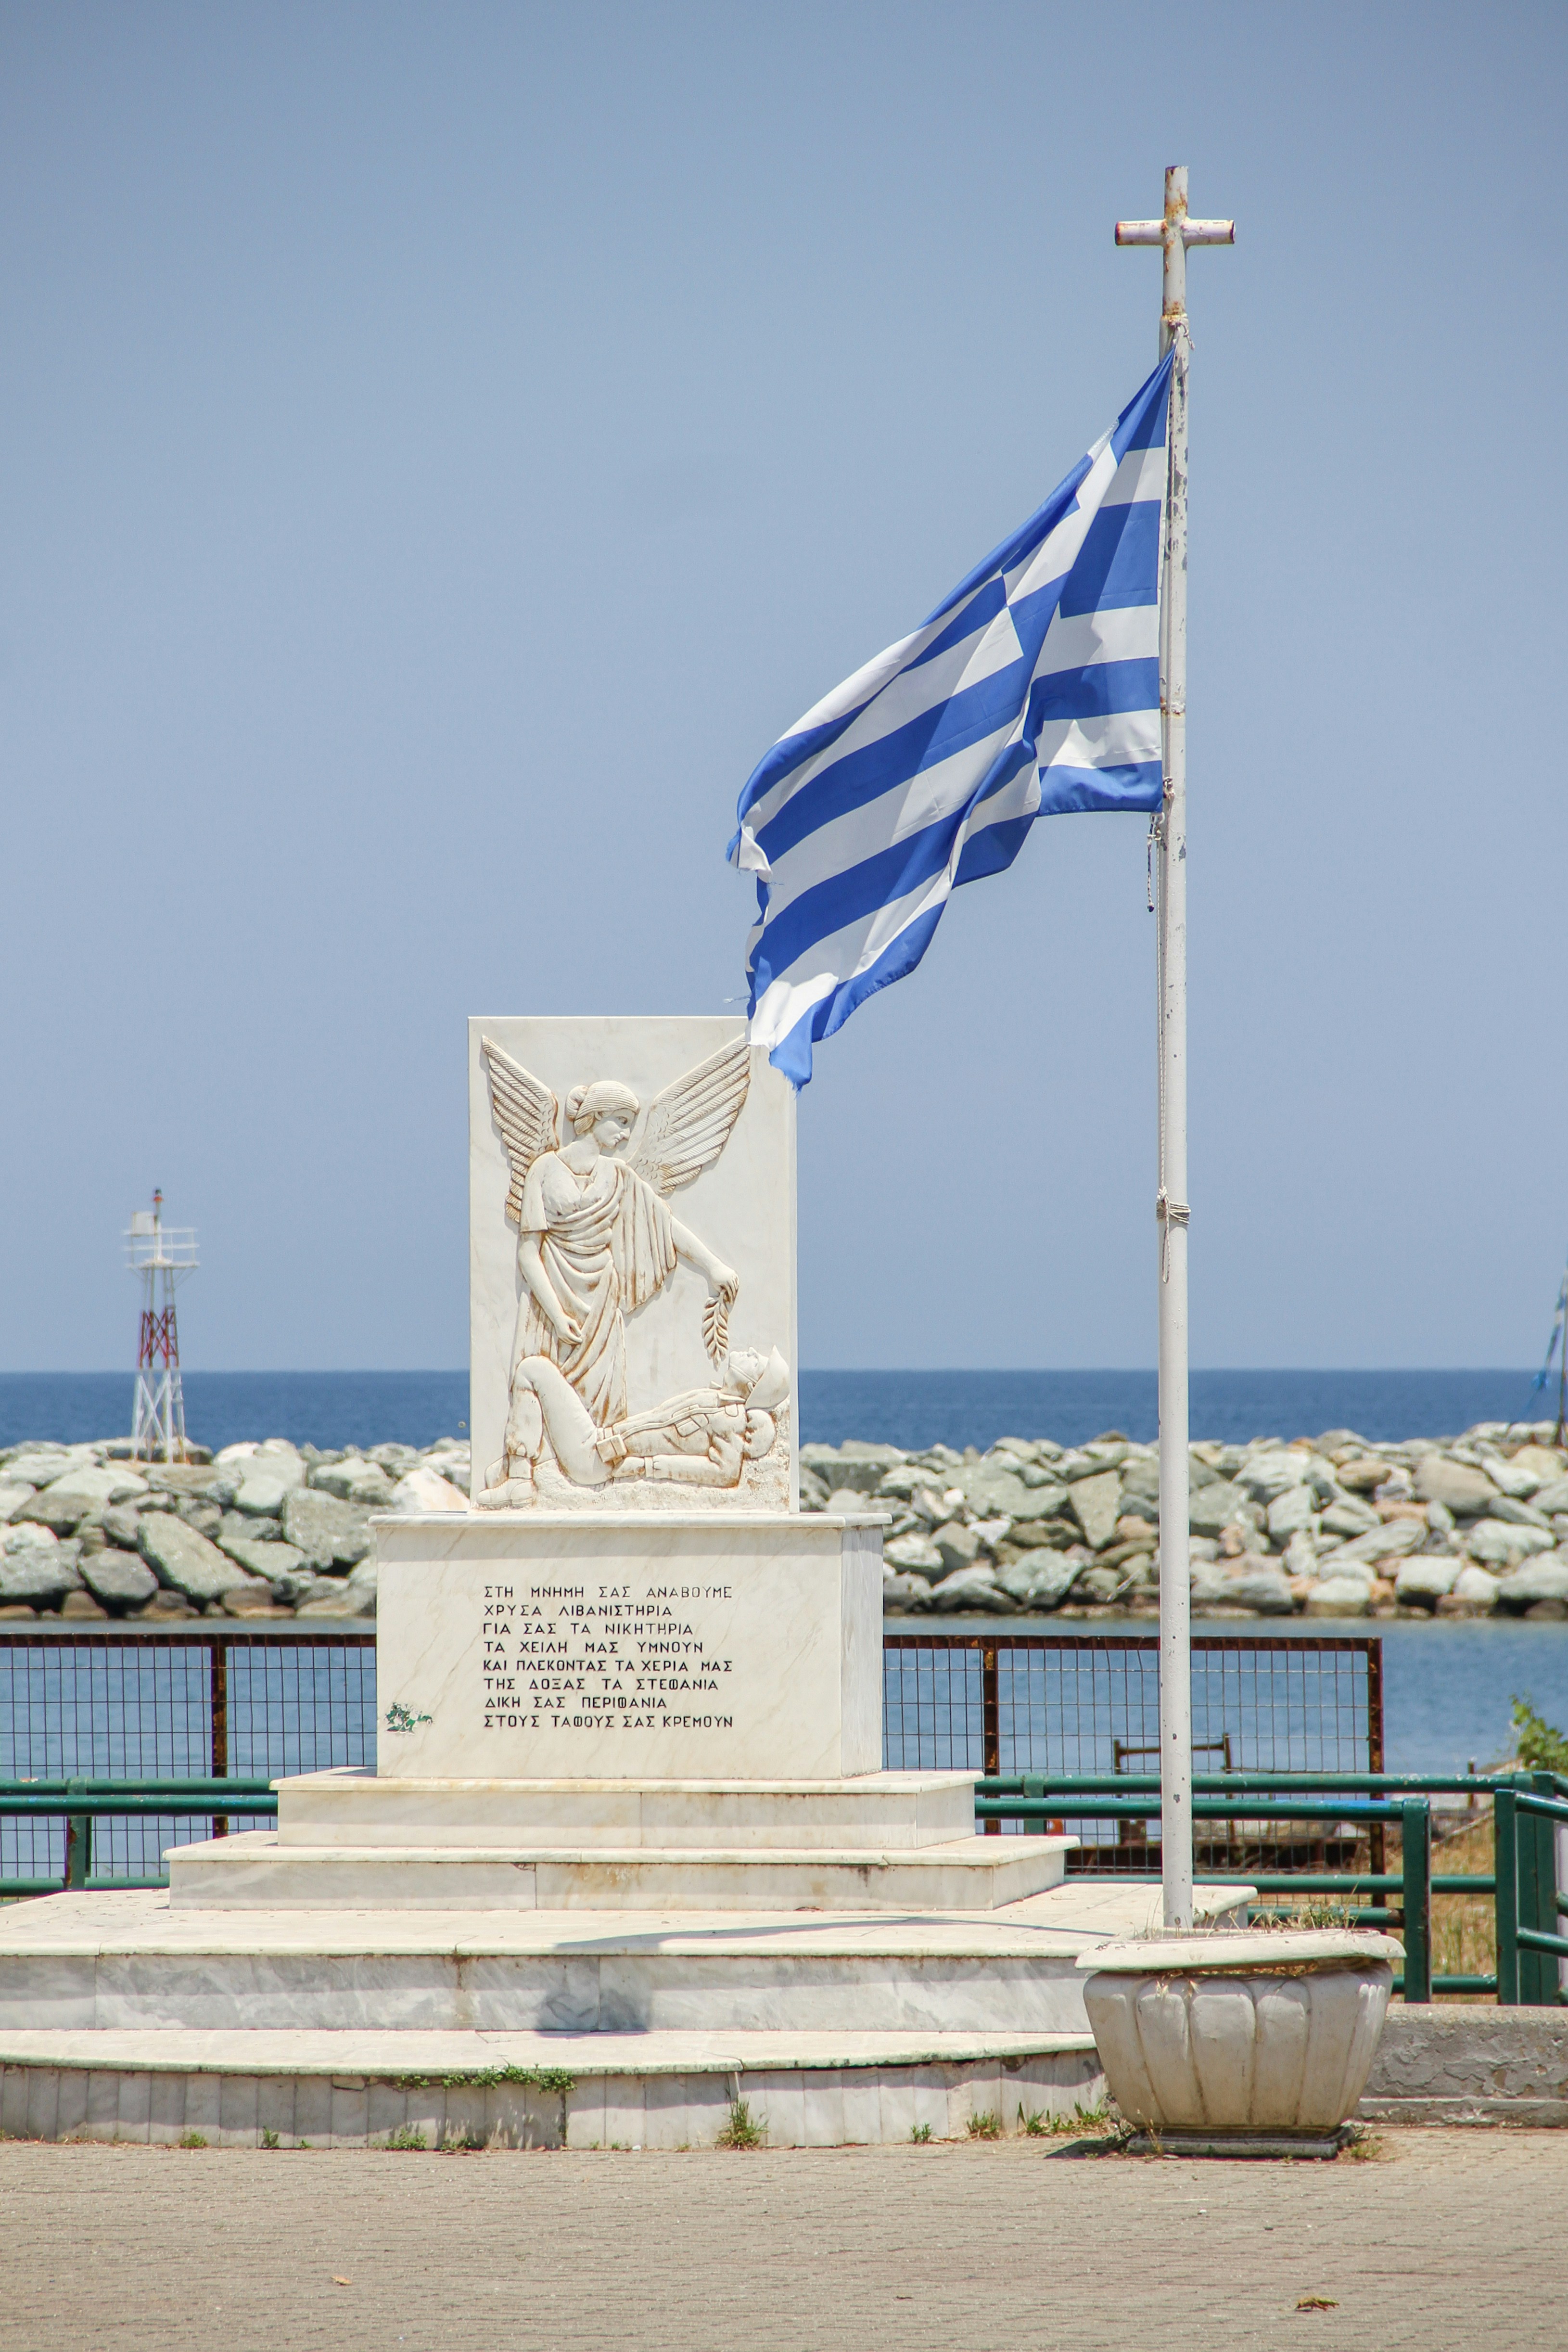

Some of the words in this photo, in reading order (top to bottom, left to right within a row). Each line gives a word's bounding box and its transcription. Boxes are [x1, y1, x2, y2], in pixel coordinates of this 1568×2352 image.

[484, 1585, 513, 1598] ΣΤΗ
[531, 1585, 584, 1598] ΜΝΗΜΗ
[599, 1585, 631, 1598] ΣΑΣ
[646, 1585, 732, 1598] ΑΝΑΒΟΥΜΕ
[484, 1604, 542, 1616] ΧΡΥΣΑ
[558, 1604, 673, 1616] ΛΙΒΑΝΙΣΤΗΡΙΑ
[483, 1623, 511, 1635] ΓΙΑ
[523, 1623, 556, 1635] ΣΑΣ
[570, 1623, 591, 1635] ΤΑ
[605, 1623, 693, 1635] ΝΙΚΗΤΗΡΙΑ
[484, 1641, 506, 1653] ΤΑ
[519, 1641, 568, 1653] ΧΕΙΛΗ
[585, 1641, 618, 1653] ΜΑΣ
[637, 1641, 703, 1653] ΥΜΝΟΥΝ
[483, 1659, 507, 1672] ΚΑΙ
[516, 1659, 607, 1672] ΠΛΕΚΟΝΤΑΣ
[615, 1659, 635, 1672] ΤΑ
[641, 1659, 688, 1672] ΧΕΡΙΑ
[701, 1659, 733, 1672] ΜΑΣ
[483, 1678, 515, 1690] ΤΗΣ
[528, 1678, 586, 1690] ΔΟΞΑΣ
[601, 1678, 623, 1690] ΤΑ
[636, 1678, 719, 1690] ΣΤΕΦΑΝΙΑ
[484, 1696, 521, 1709] ΔΙΚΗ
[533, 1696, 566, 1709] ΣΑΣ
[581, 1696, 667, 1709] ΠΕΡΙΦΑΝΙΑ
[484, 1714, 540, 1728] ΣΤΟΥΣ
[550, 1714, 615, 1728] ΤΑΦΟΥΣ
[622, 1714, 655, 1728] ΣΑΣ
[663, 1714, 733, 1728] ΚΡΕΜΟΥΝ
